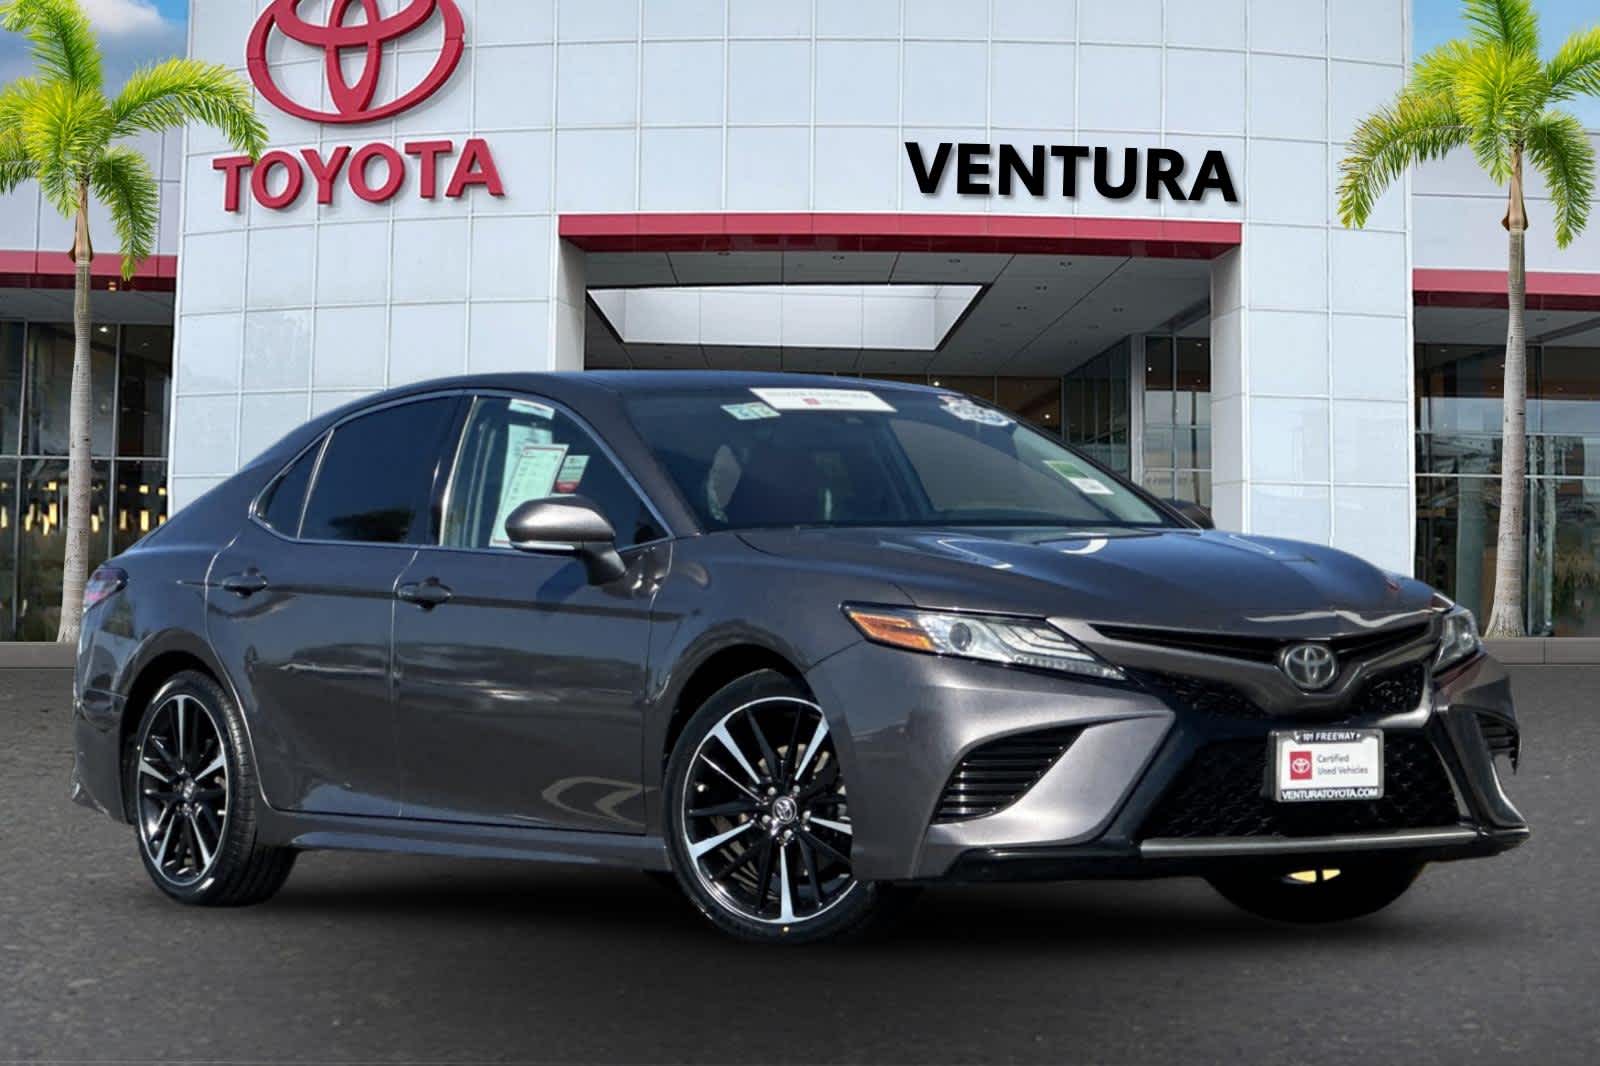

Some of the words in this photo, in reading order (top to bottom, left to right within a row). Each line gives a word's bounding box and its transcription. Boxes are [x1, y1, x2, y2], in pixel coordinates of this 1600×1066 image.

[212, 138, 505, 212] TOYOTA
[904, 142, 1238, 203] VENTURA
[1315, 732, 1355, 741] FREEWAY
[1317, 754, 1349, 763] Certified
[1317, 767, 1337, 775] Used
[1338, 764, 1368, 775] Vehicles
[1281, 788, 1378, 801] VENTURATOYOTA.COM
